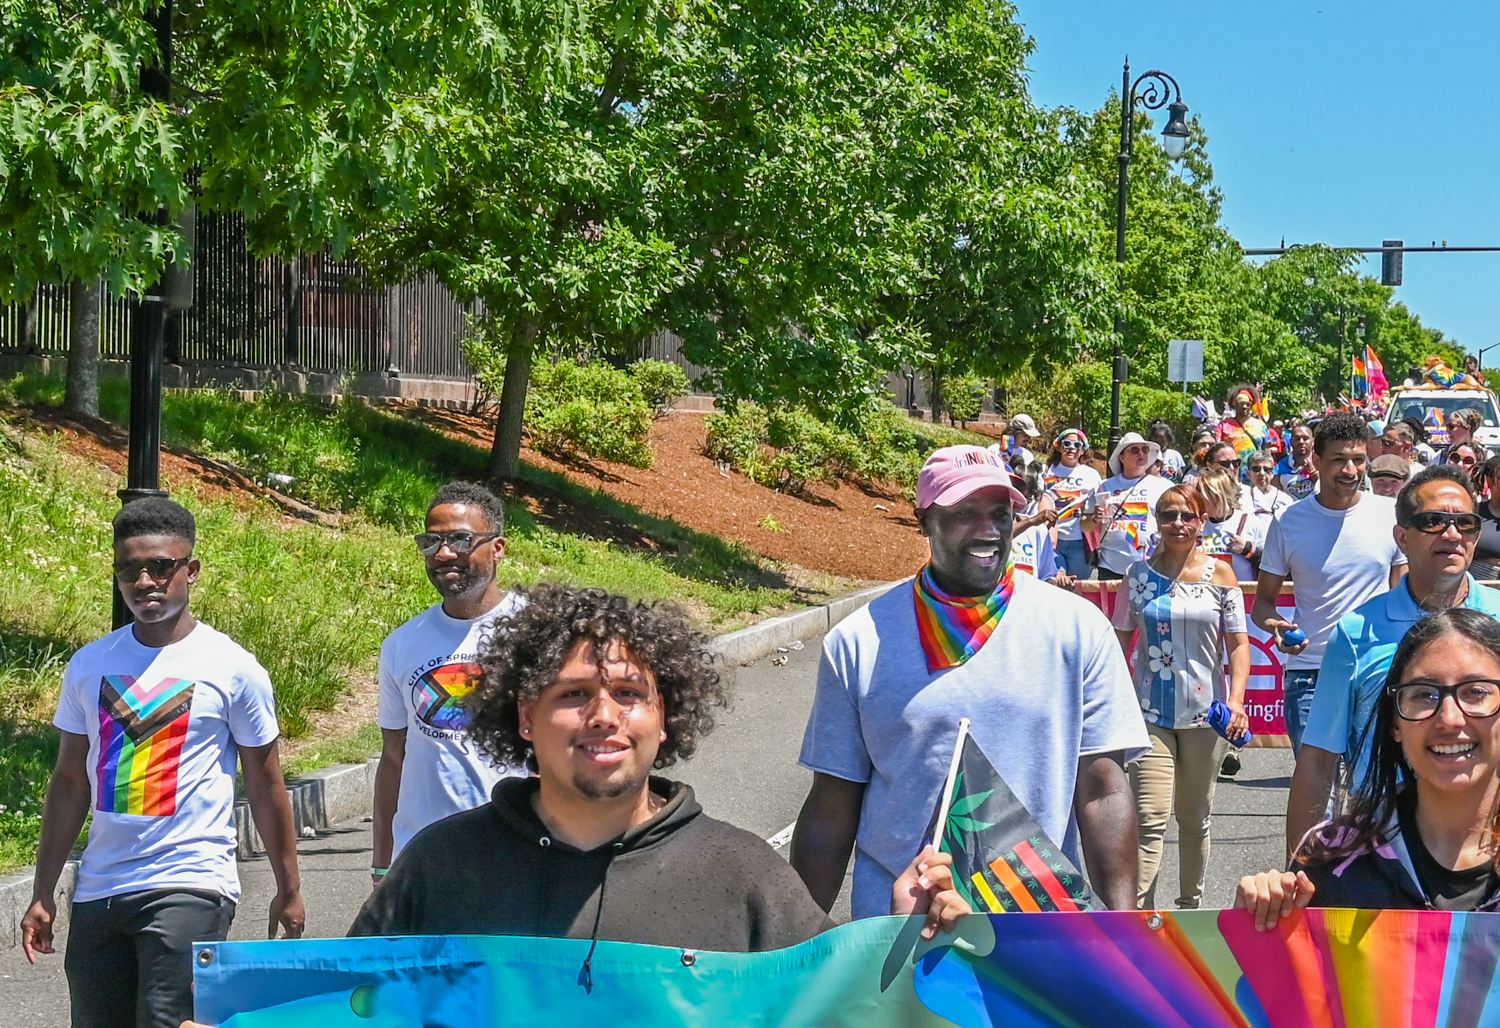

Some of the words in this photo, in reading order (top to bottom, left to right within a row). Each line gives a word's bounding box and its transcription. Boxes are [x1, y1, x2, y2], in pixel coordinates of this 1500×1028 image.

[408, 664, 425, 687] CITY
[427, 656, 443, 668] OF
[1243, 699, 1284, 722] ringfi
[414, 717, 461, 741] EVELOPME
